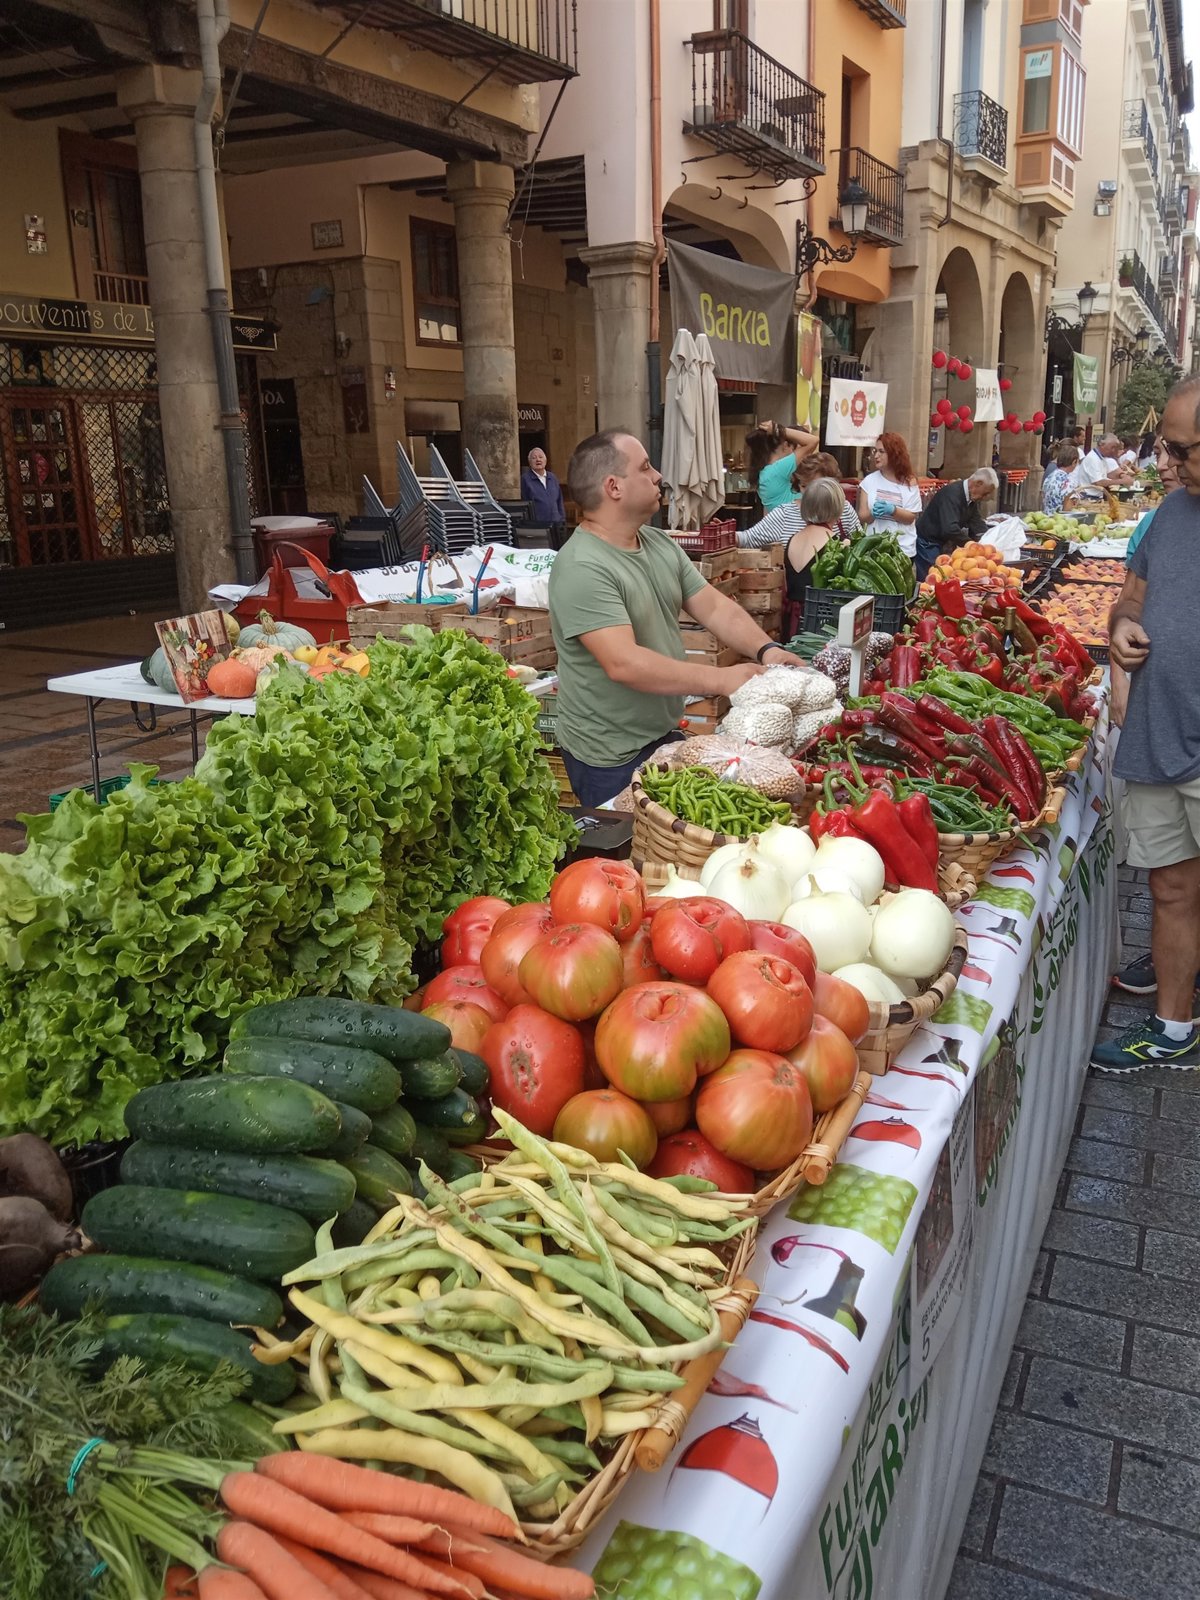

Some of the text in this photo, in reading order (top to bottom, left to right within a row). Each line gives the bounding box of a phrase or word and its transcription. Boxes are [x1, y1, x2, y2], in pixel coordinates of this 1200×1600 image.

[0, 302, 104, 330] ouvenirs
[113, 307, 137, 332] de
[700, 293, 771, 347] Bankia
[921, 1326, 931, 1362] 5
